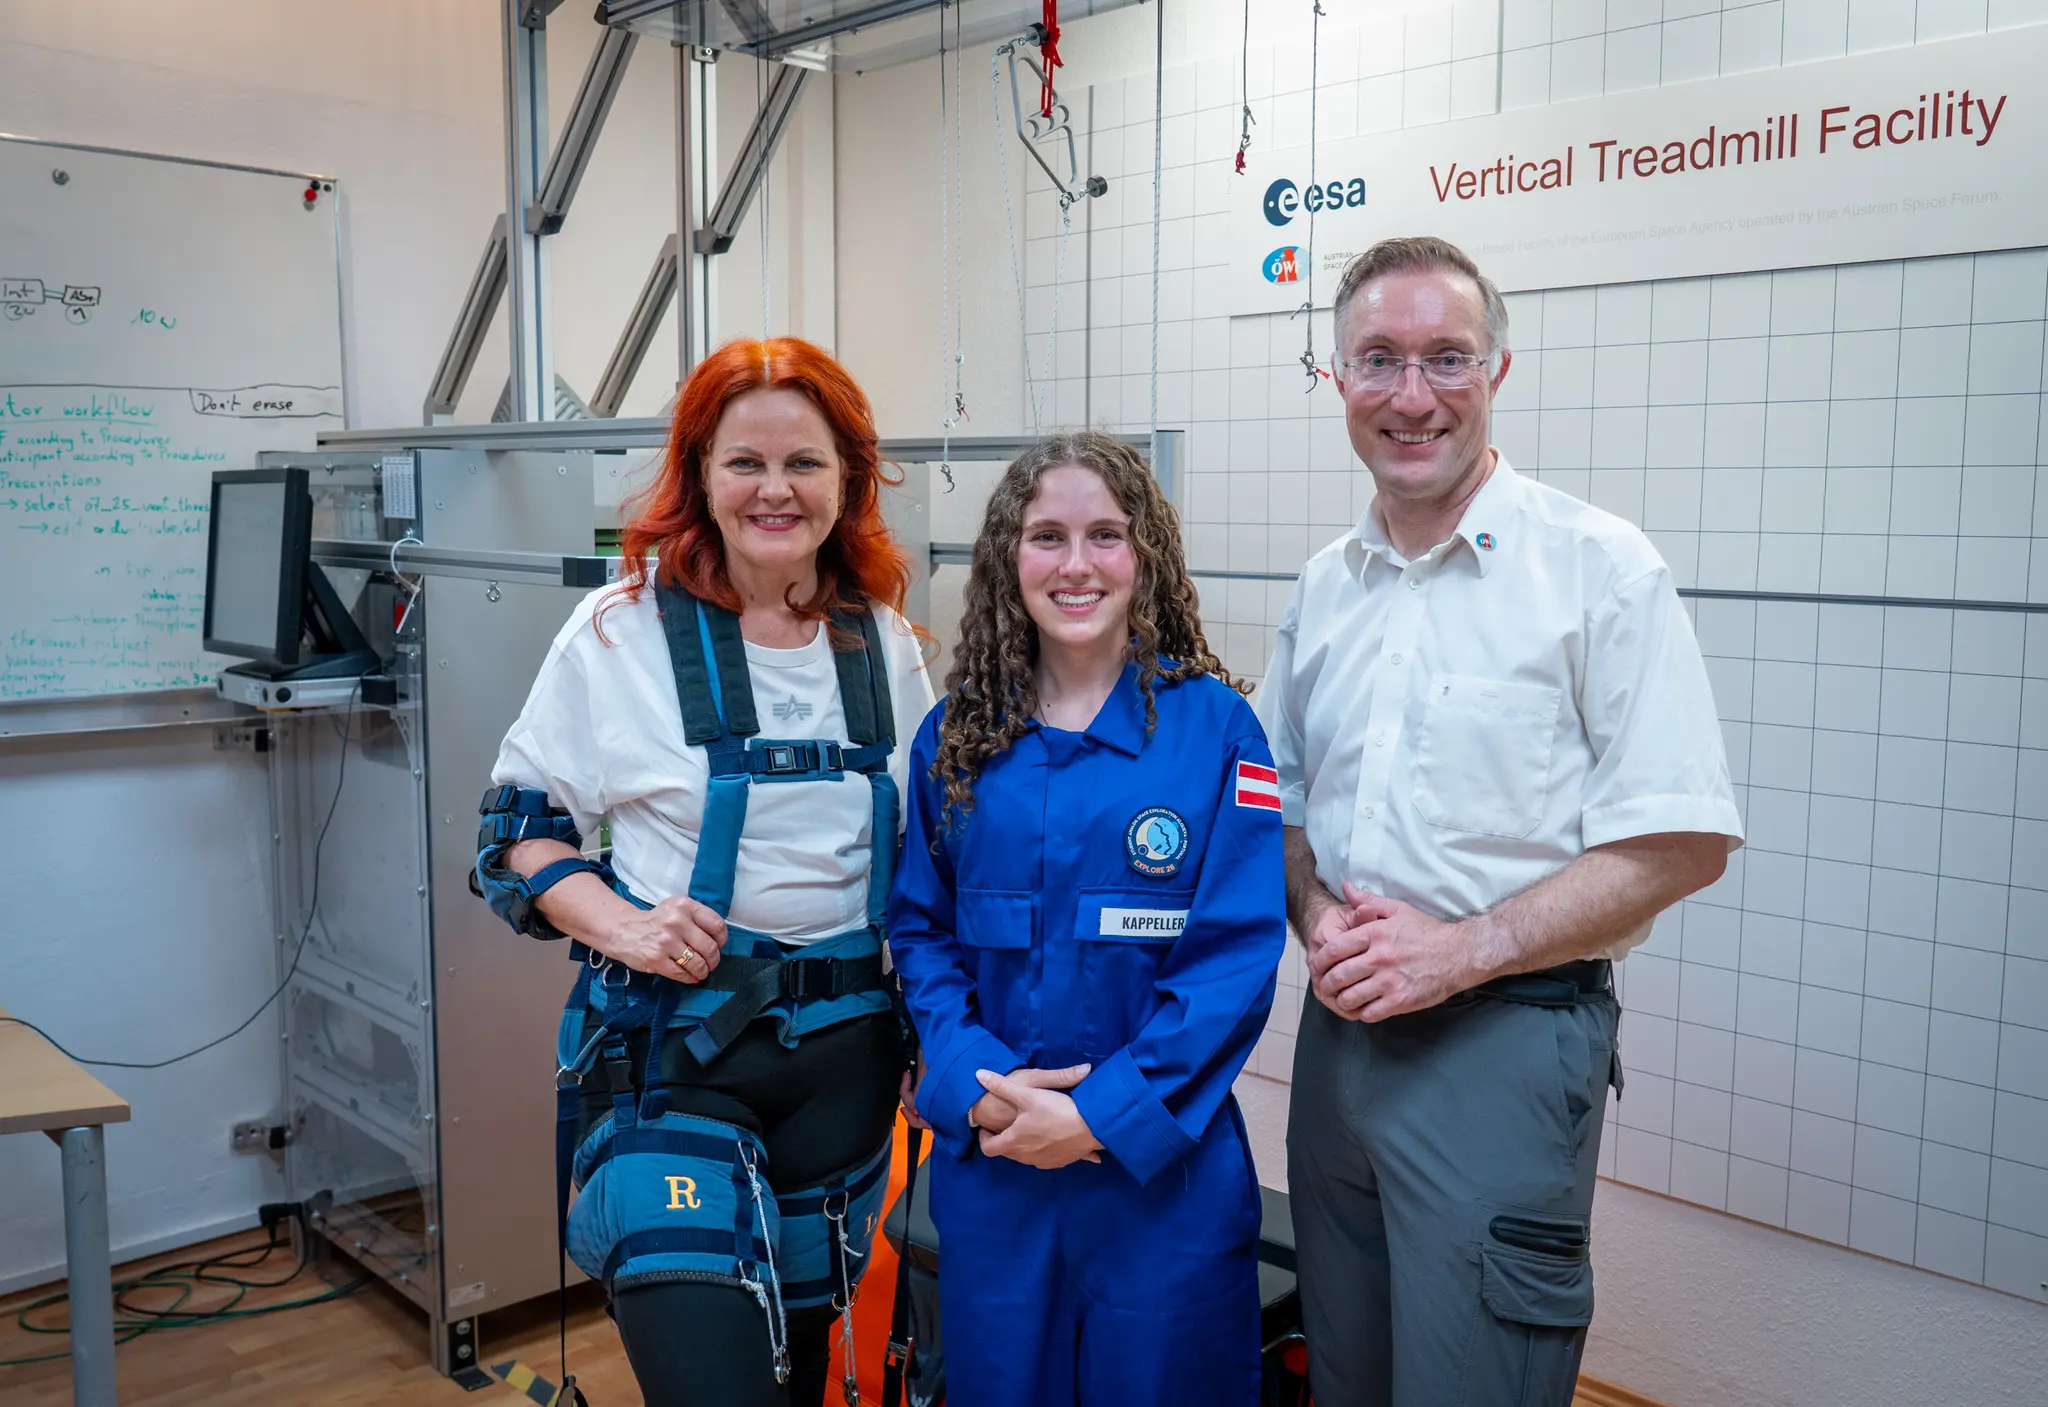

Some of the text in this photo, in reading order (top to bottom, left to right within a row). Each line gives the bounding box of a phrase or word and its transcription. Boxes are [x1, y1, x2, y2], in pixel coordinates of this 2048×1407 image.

[1430, 89, 2007, 203] Vertical Treadmill Facility
[1304, 178, 1366, 213] esa
[1571, 231, 1588, 246] the
[1591, 229, 1646, 246] European
[1649, 224, 1686, 241] Space
[1690, 217, 1736, 235] Agency
[1739, 211, 1794, 230] operated
[1798, 210, 1813, 225] by
[1817, 207, 1837, 219] the
[1842, 200, 1898, 217] Austrian
[1902, 195, 1947, 213] Space
[1951, 189, 2003, 205] Forum.
[63, 391, 155, 424] workflow
[198, 393, 293, 411] Don't erase
[81, 428, 94, 444] to
[0, 470, 102, 494] Prescriptions
[24, 494, 72, 512] select
[1134, 859, 1165, 874] EXPLORE
[1122, 916, 1185, 931] KAPPELLER
[664, 1175, 701, 1209] R
